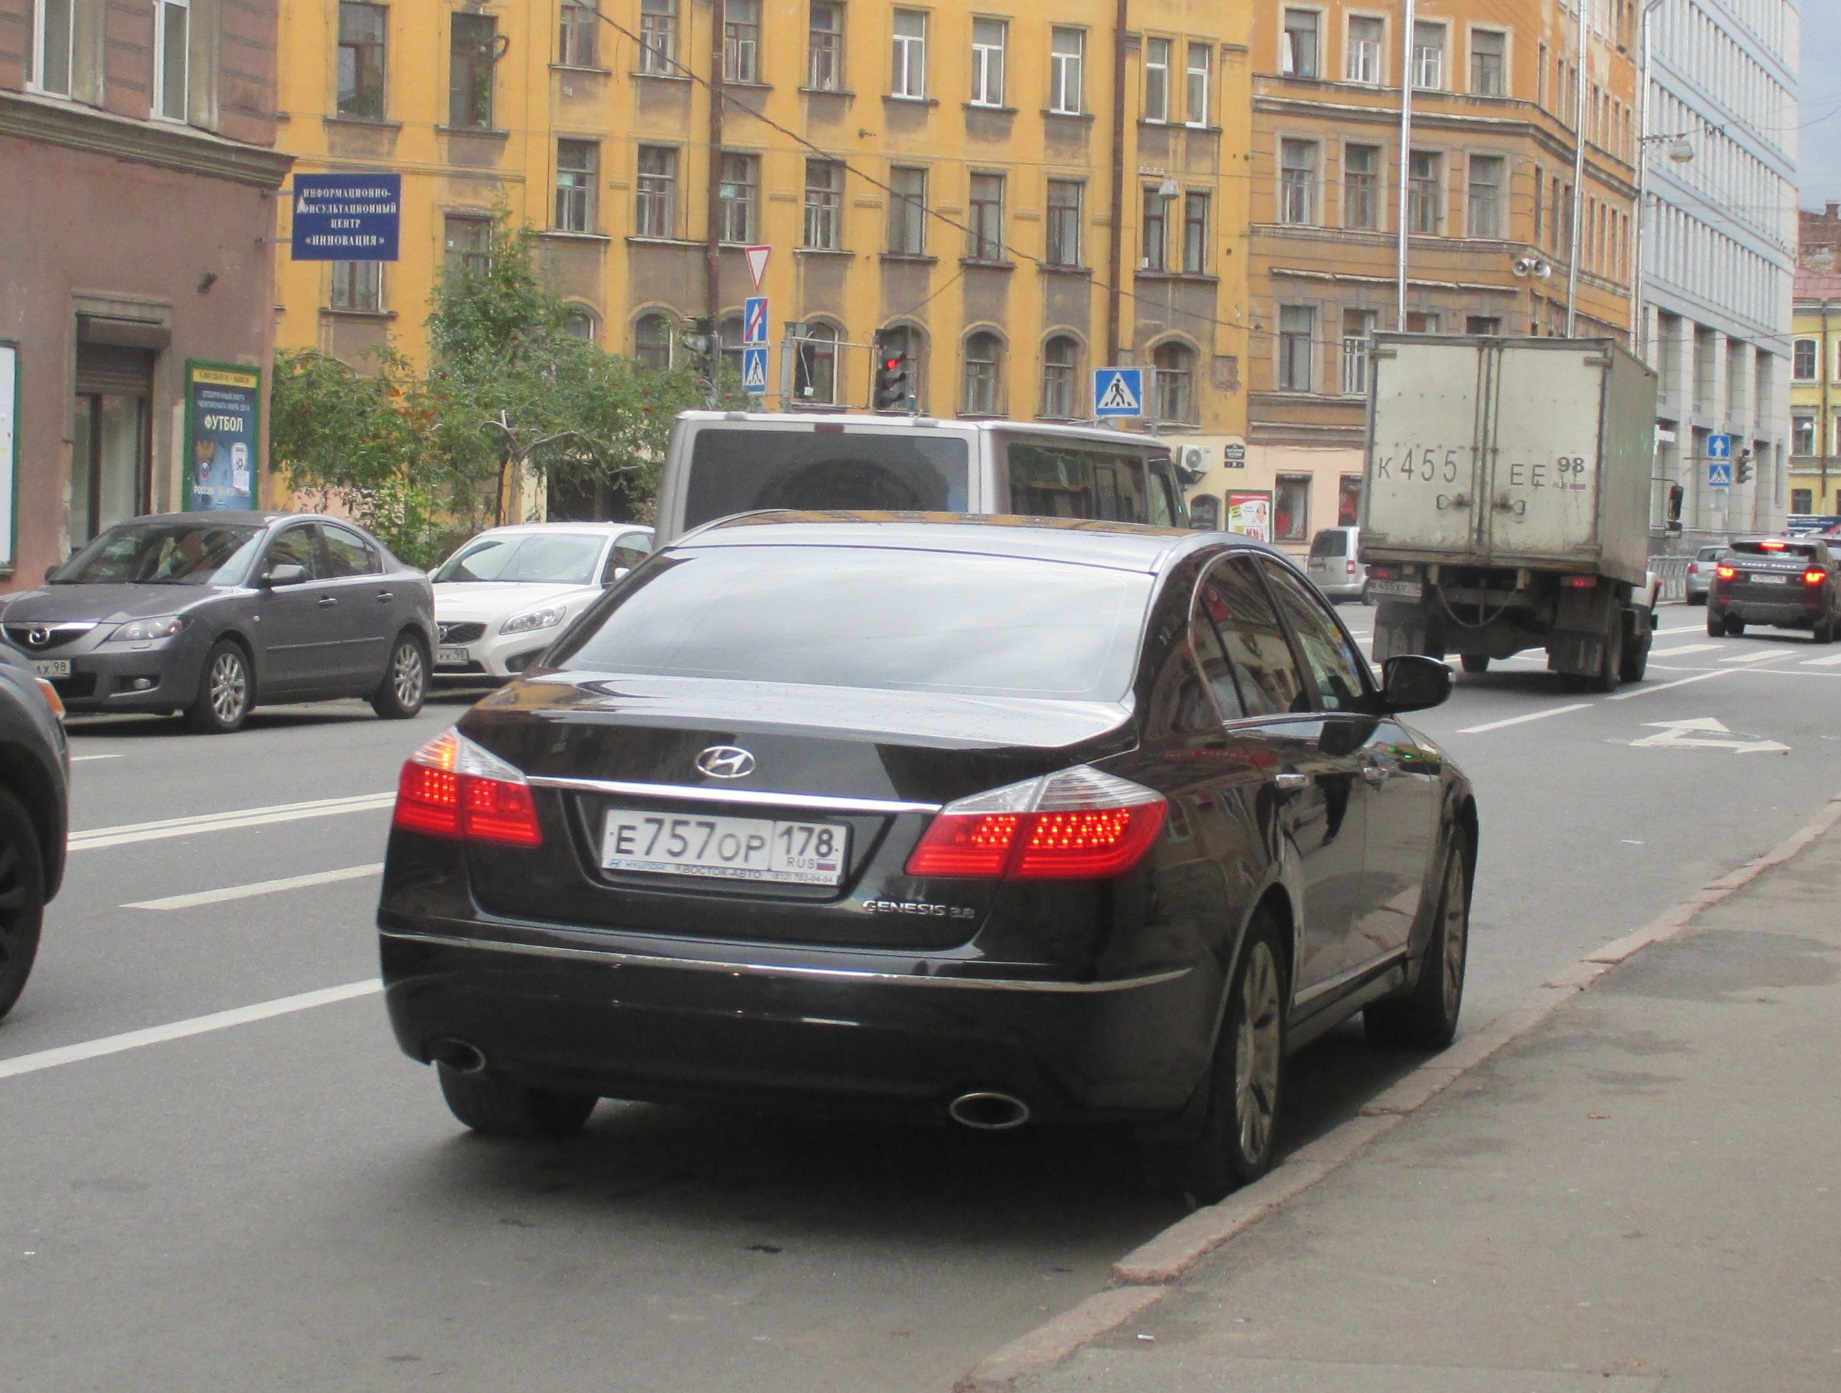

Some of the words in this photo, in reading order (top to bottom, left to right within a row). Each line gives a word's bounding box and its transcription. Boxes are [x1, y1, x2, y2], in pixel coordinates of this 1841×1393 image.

[303, 188, 391, 198] ИНФОРМАЦИОННО-
[331, 219, 361, 229] ЦЕНТР
[204, 414, 243, 432] ФУТБОЛ
[1557, 456, 1585, 473] 98
[54, 661, 67, 672] 98
[779, 825, 834, 858] 178
[787, 857, 815, 870] RUS
[862, 900, 946, 916] GENESIS
